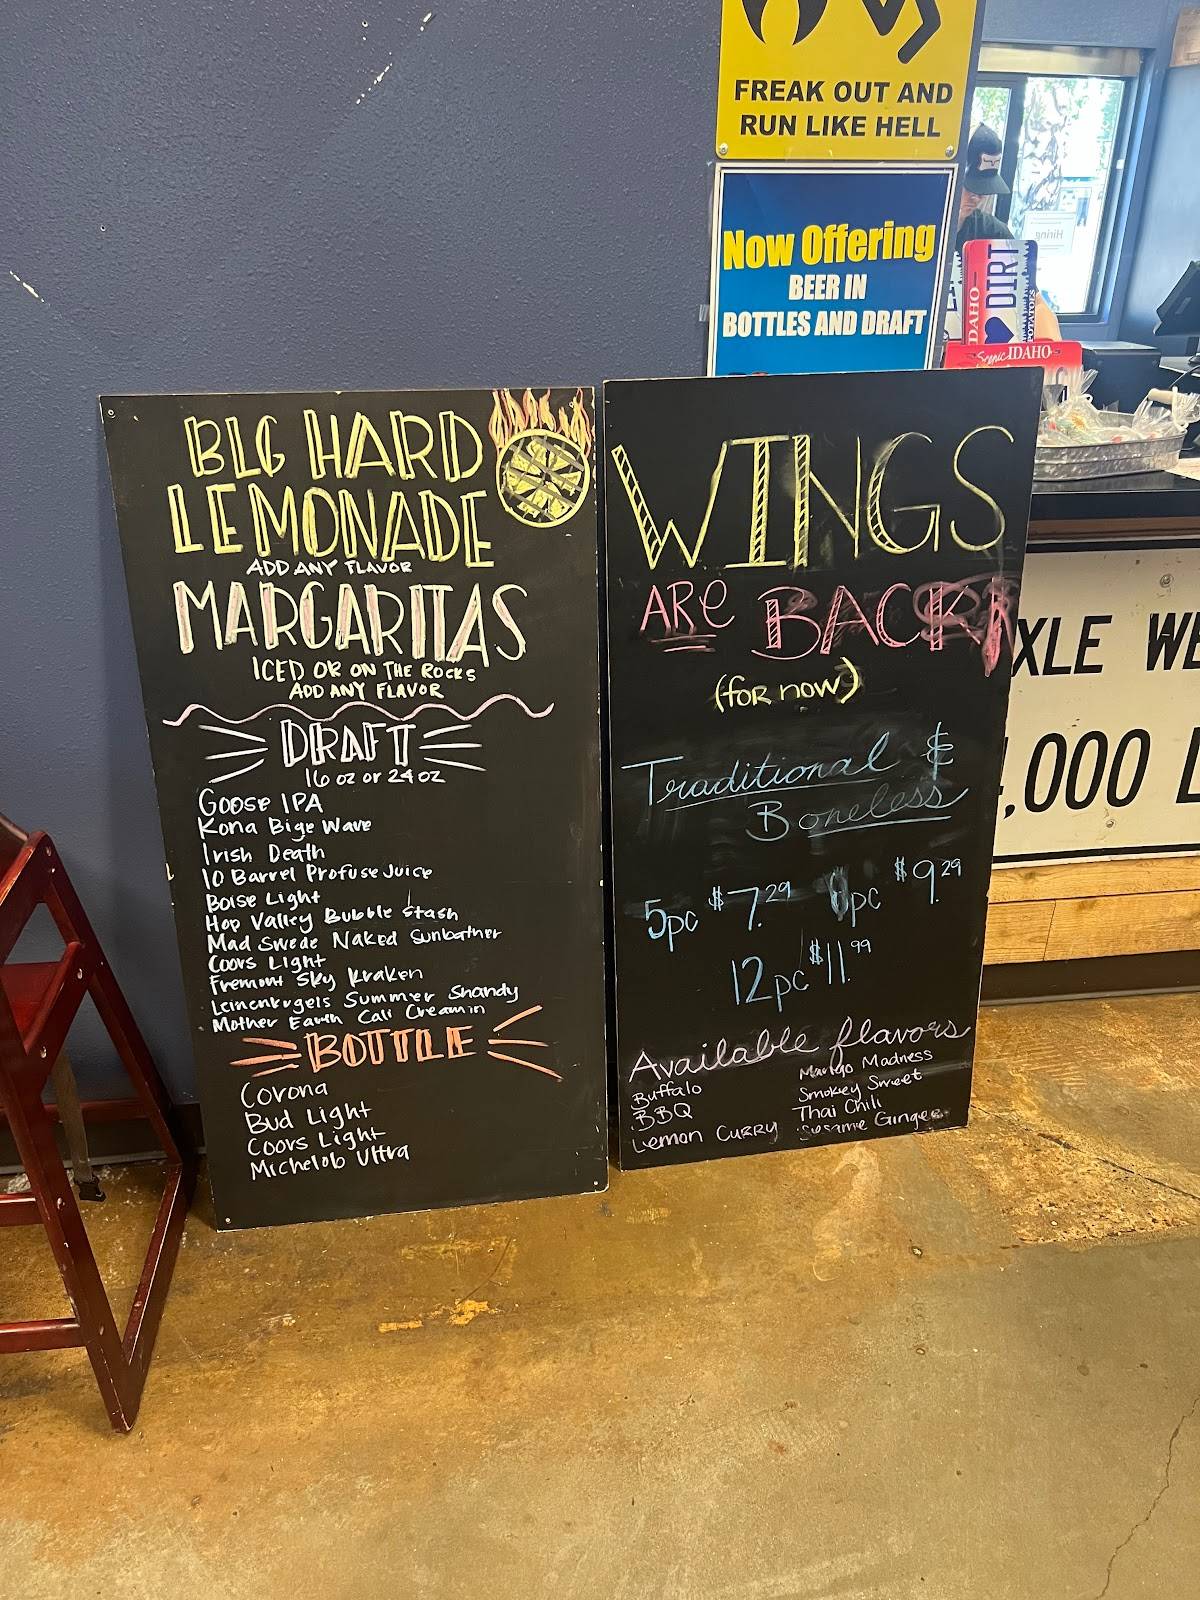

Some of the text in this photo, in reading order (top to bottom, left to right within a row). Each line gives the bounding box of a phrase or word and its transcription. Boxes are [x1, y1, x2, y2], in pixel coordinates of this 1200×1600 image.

[734, 79, 954, 104] FREAK OUT AND
[740, 115, 941, 138] RUN LIKE HELL
[722, 220, 936, 271] Now Offering
[788, 274, 868, 300] BEER IN
[985, 243, 1019, 308] DIRT
[722, 310, 928, 338] BOTTLES AND DRAFT
[1007, 344, 1053, 360] IDAHO
[303, 409, 484, 483] HARD
[611, 424, 1016, 570] WINGS
[167, 482, 495, 568] LEMONADE
[246, 558, 413, 576] ADD ANY FLAVOR
[172, 581, 529, 668] MARGARITAS
[252, 656, 305, 682] ICED
[313, 660, 342, 679] OR
[350, 661, 377, 677] ON
[383, 661, 413, 681] THE
[289, 681, 445, 700] ADD ANY FLAVOR
[714, 673, 772, 713] (for
[280, 719, 416, 767] DRAFT
[304, 768, 330, 788] 16
[336, 772, 355, 784] oz
[362, 770, 382, 783] or
[387, 768, 414, 784] 24
[621, 731, 900, 806] Traditional
[998, 728, 1151, 820] ,000
[198, 788, 324, 817] Goose IPA
[745, 784, 970, 843] Boneless
[197, 816, 258, 840] Kona
[321, 817, 372, 835] Wave
[202, 842, 326, 866] Irish Death
[202, 866, 225, 890] 10
[231, 867, 297, 886] Barrel
[382, 864, 433, 880] Juice
[205, 889, 321, 914] Boise Light
[205, 914, 241, 933] Hop
[250, 911, 314, 934] Valley
[323, 906, 393, 925] Bubble
[643, 898, 699, 953] 5pc
[207, 932, 251, 954] Mad
[257, 936, 319, 951] Swede
[332, 930, 398, 950] Naked
[208, 953, 327, 974] Coors Light
[209, 974, 284, 996] Fremont
[296, 970, 336, 992] Sky
[343, 991, 436, 1009] Summer
[448, 982, 519, 1004] Shandy
[212, 1013, 279, 1033] Mother
[357, 1009, 393, 1025] Cali
[304, 1025, 478, 1073] BOTTLE
[629, 1016, 971, 1083] Available flavors
[862, 1049, 933, 1069] Madness
[867, 1068, 923, 1090] Sweet
[240, 1081, 329, 1109] Corona
[630, 1081, 702, 1110] Buffalo
[792, 1094, 882, 1122] Thai Chili
[245, 1100, 372, 1134] Bud Light
[247, 1126, 386, 1157] Coors Light
[632, 1130, 703, 1153] Lemon
[250, 1144, 410, 1180] Michelob Ultra
